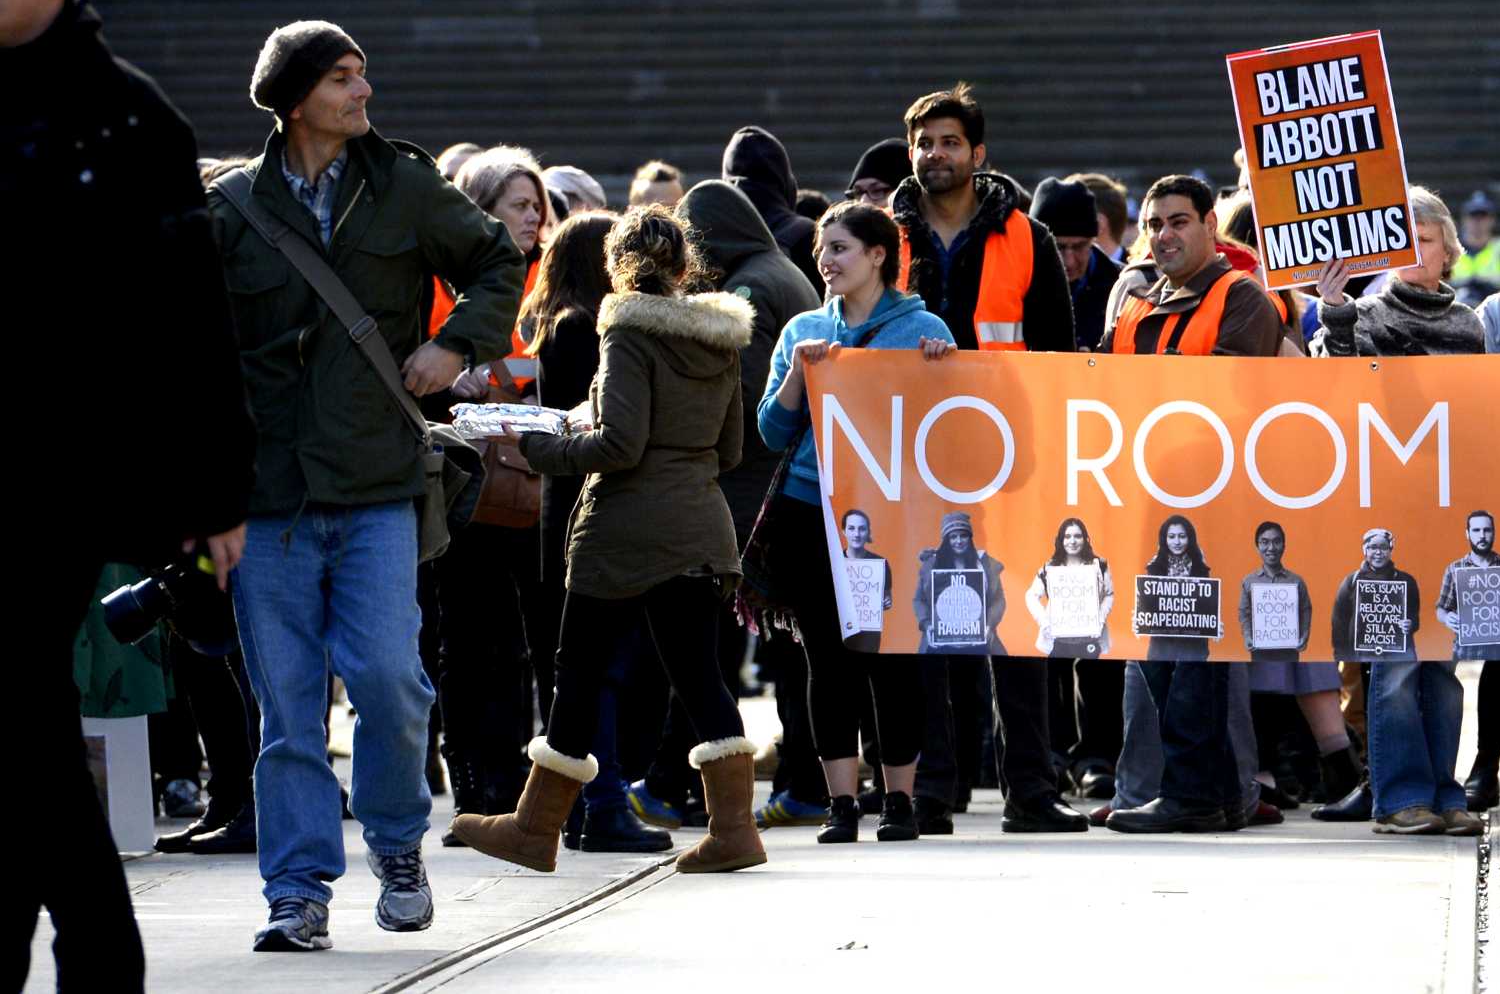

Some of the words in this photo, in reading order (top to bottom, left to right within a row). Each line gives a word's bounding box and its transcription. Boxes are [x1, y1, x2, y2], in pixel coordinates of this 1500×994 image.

[1256, 57, 1365, 116] BLAME
[1262, 106, 1376, 168] ABBOTT
[1294, 162, 1356, 214] NOT
[1264, 207, 1408, 270] MUSLIMS
[822, 394, 1015, 504] NO
[1066, 399, 1450, 508] ROOM
[951, 574, 967, 587] NO
[1468, 573, 1500, 589] #NO
[1144, 580, 1179, 596] STAND
[1182, 581, 1195, 597] UP
[1198, 583, 1212, 597] TO
[1262, 589, 1289, 601] #NO
[1379, 584, 1404, 594] ISLAM
[1158, 597, 1197, 612] RACIST
[1373, 594, 1381, 603] IS
[1382, 594, 1390, 603] A
[1256, 602, 1295, 614] ROOM
[1472, 606, 1500, 621] FOR
[1138, 611, 1217, 628] SCAPEGOATING
[1264, 615, 1287, 627] FOR
[1361, 613, 1382, 623] YOU
[1383, 614, 1401, 623] ARE
[938, 620, 981, 636] RACISM
[1255, 629, 1297, 641] RACISM
[1366, 624, 1386, 634] STILL
[1388, 625, 1396, 634] A
